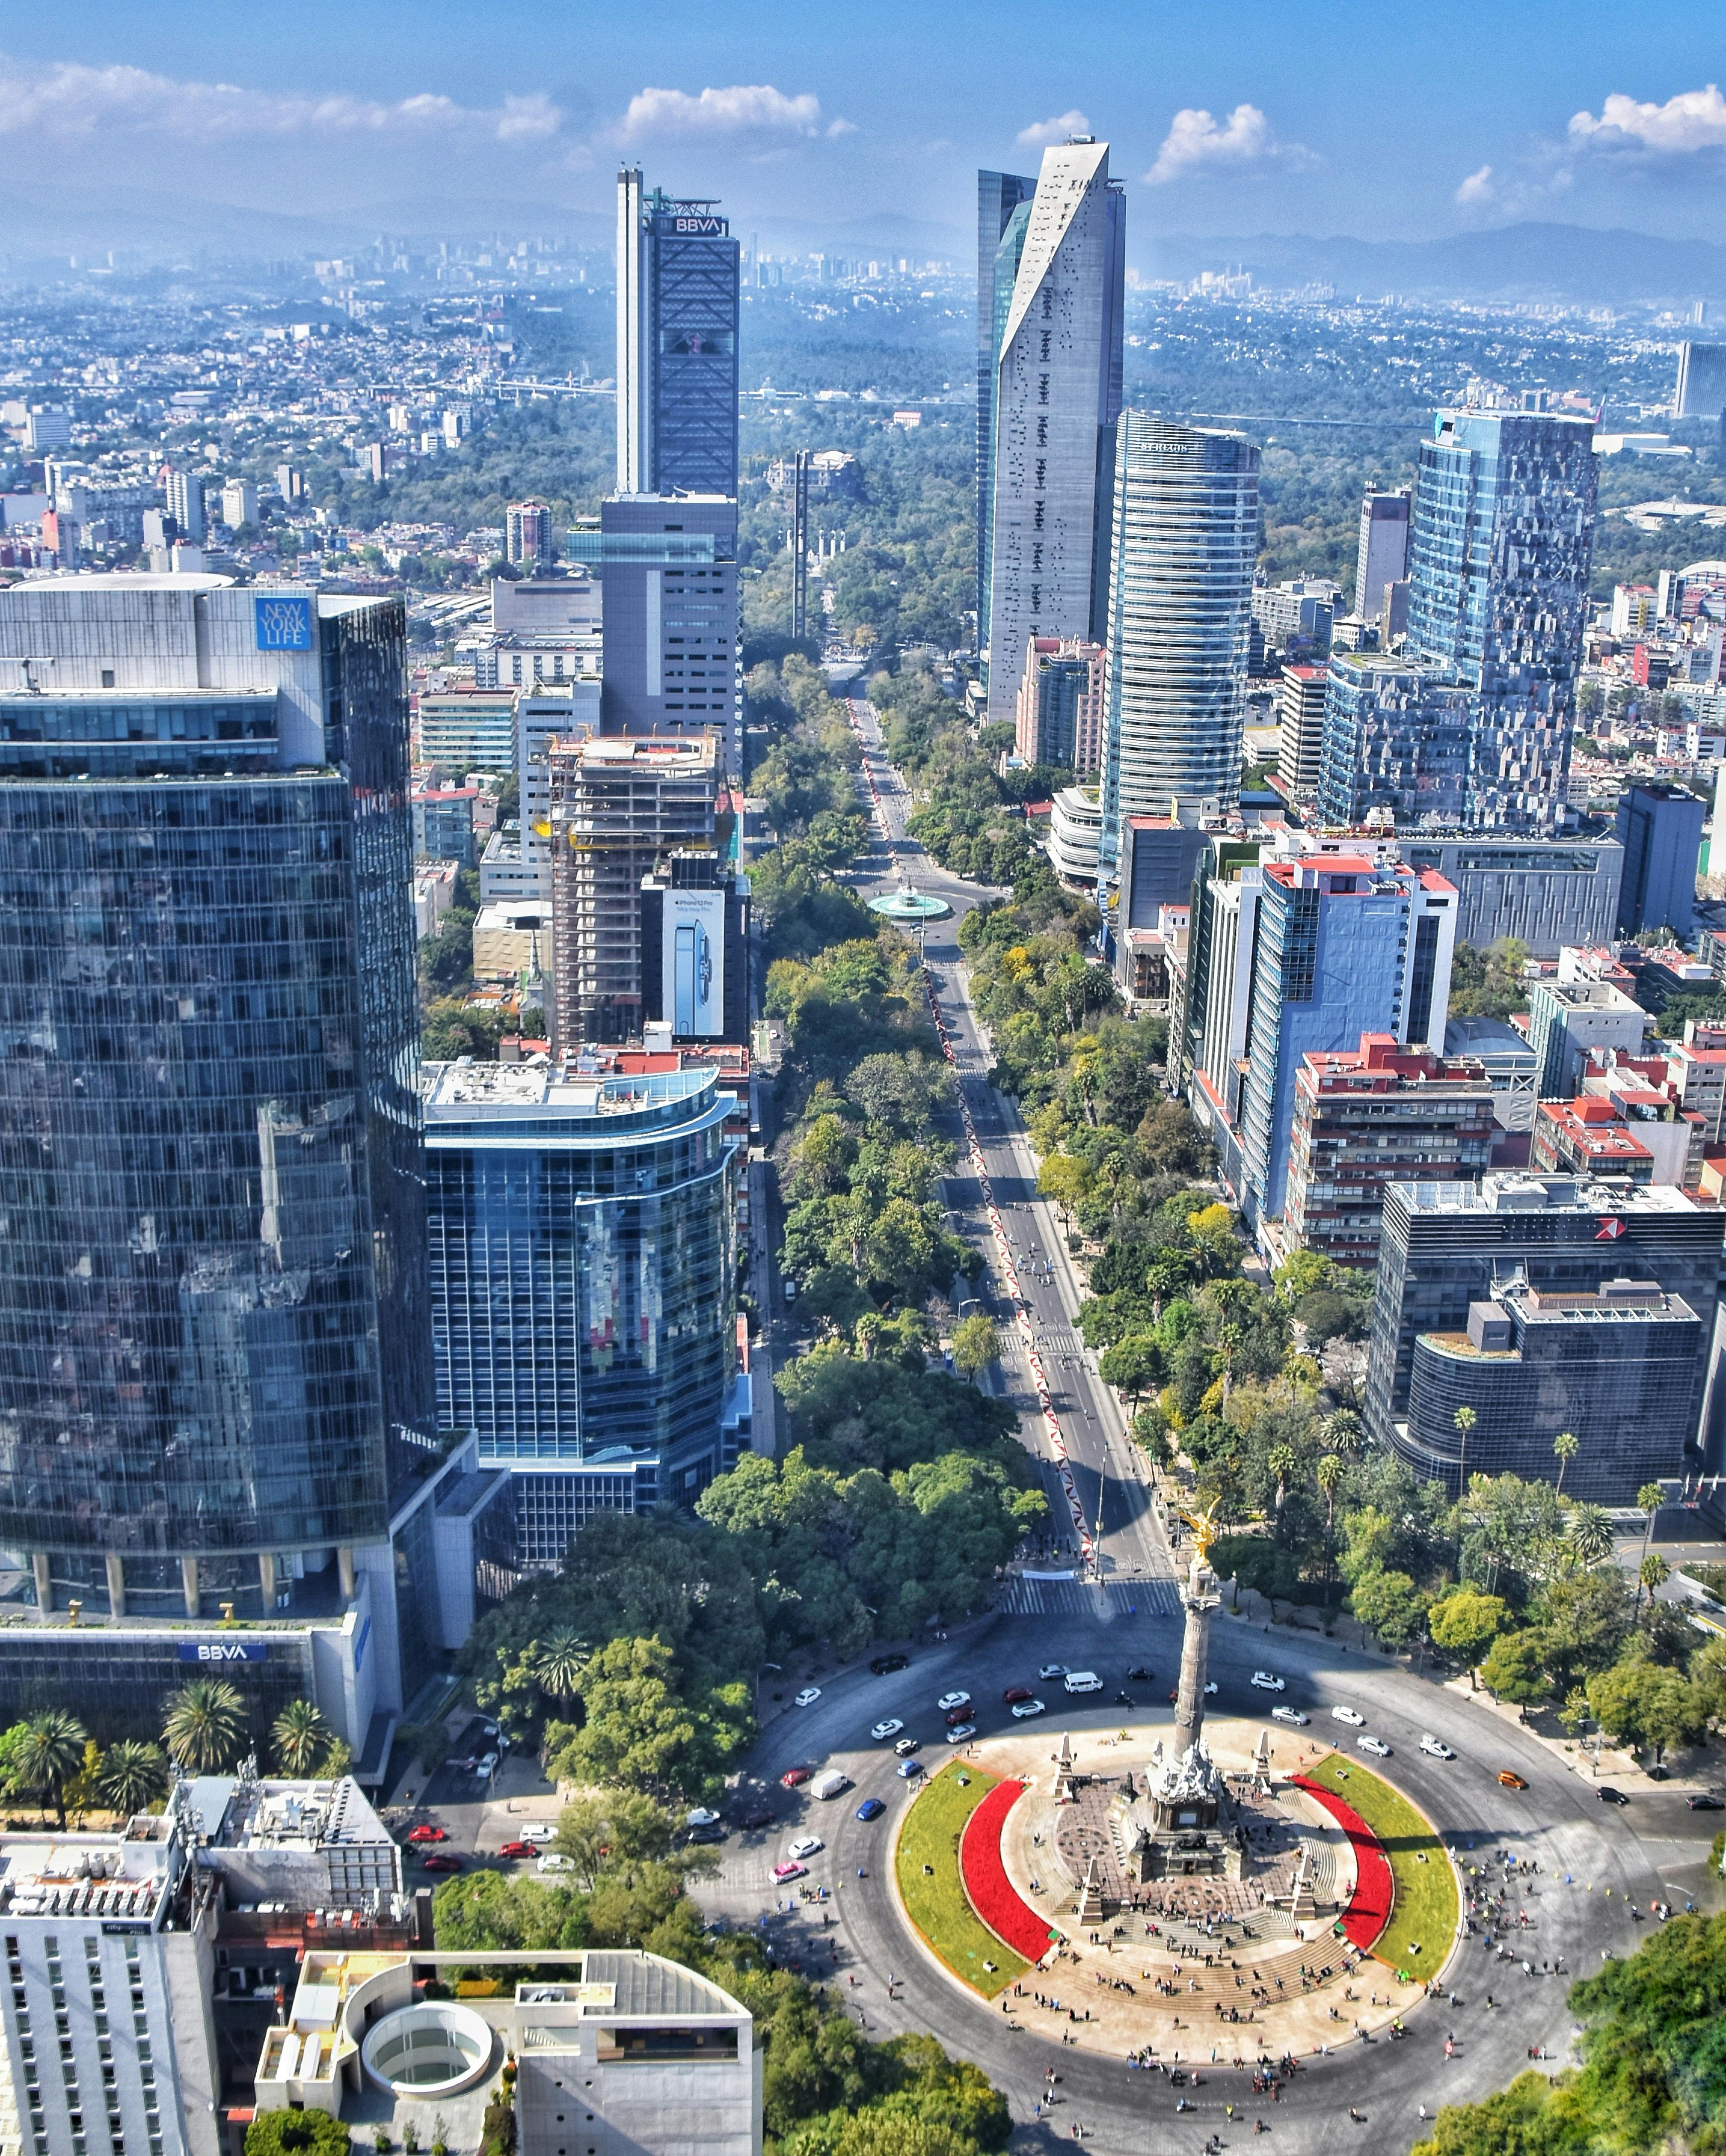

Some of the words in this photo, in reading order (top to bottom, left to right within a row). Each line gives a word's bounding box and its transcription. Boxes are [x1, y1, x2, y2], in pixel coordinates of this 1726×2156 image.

[677, 218, 719, 232] BBVA
[265, 603, 301, 618] NEW
[260, 616, 306, 631] YORK
[267, 630, 302, 644] LIFE
[198, 1645, 247, 1660] BBVA
